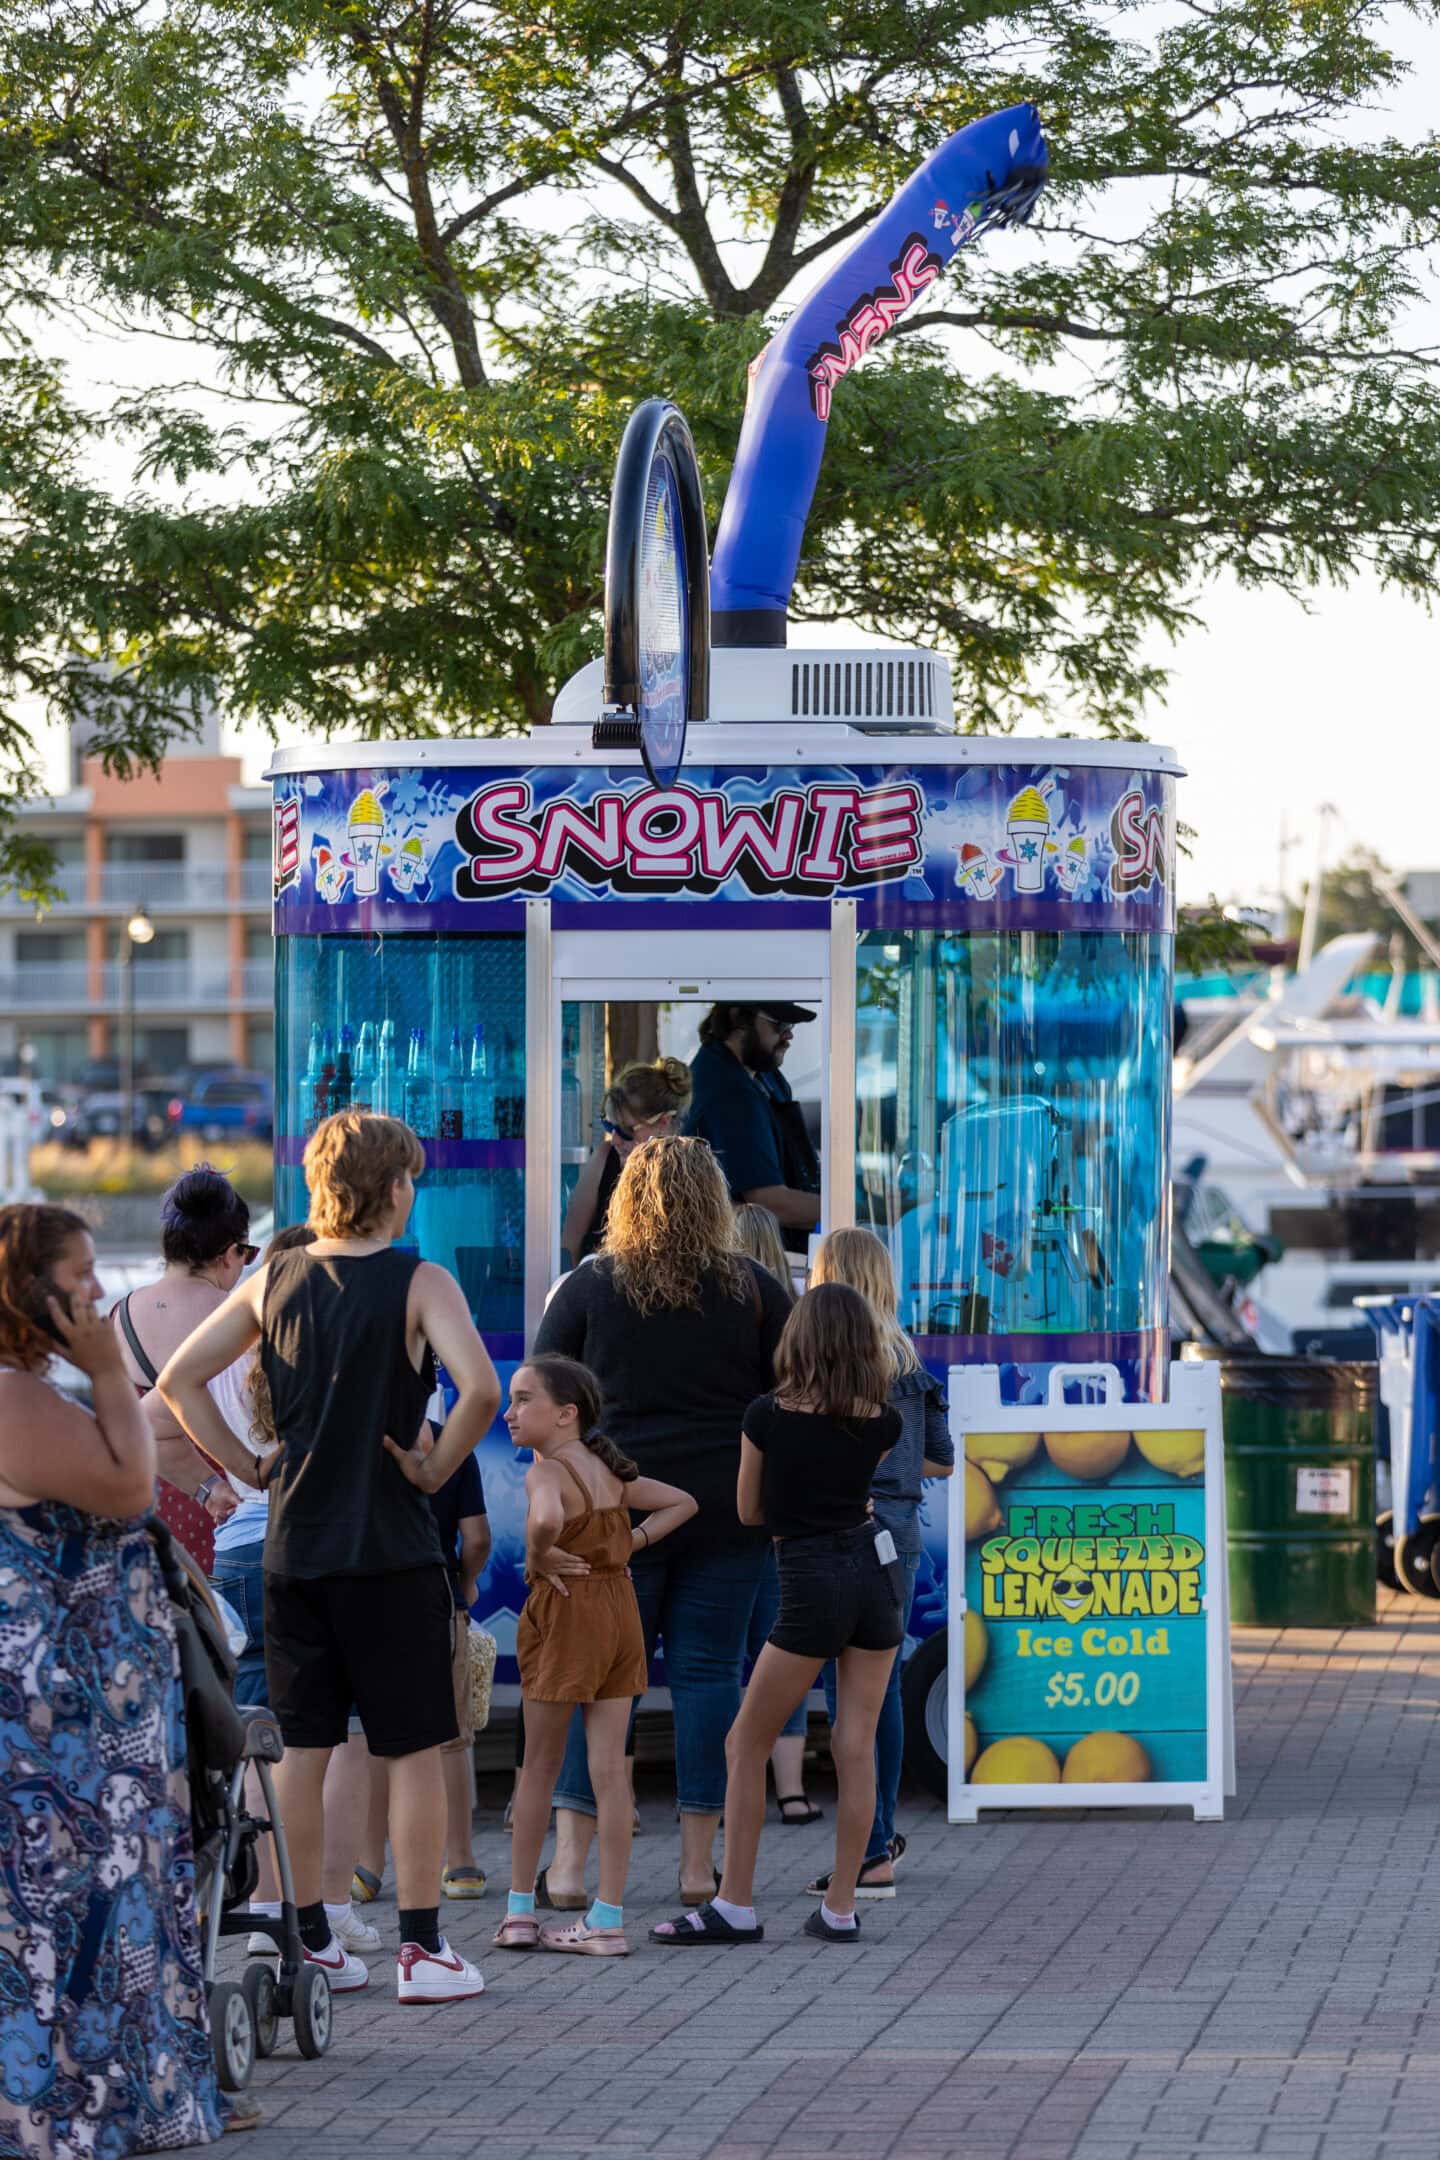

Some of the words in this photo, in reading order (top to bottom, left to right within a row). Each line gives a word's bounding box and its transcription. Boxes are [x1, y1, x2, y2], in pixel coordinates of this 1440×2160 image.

[473, 786, 918, 881] SNOWIE
[1008, 1503, 1175, 1537] FRESH
[980, 1534, 1205, 1575] SQUEEZED
[982, 1565, 1201, 1624] LEMONADE
[1016, 1629, 1073, 1657] Ice
[1081, 1627, 1170, 1656] Cold
[1045, 1671, 1140, 1709] $5.00
